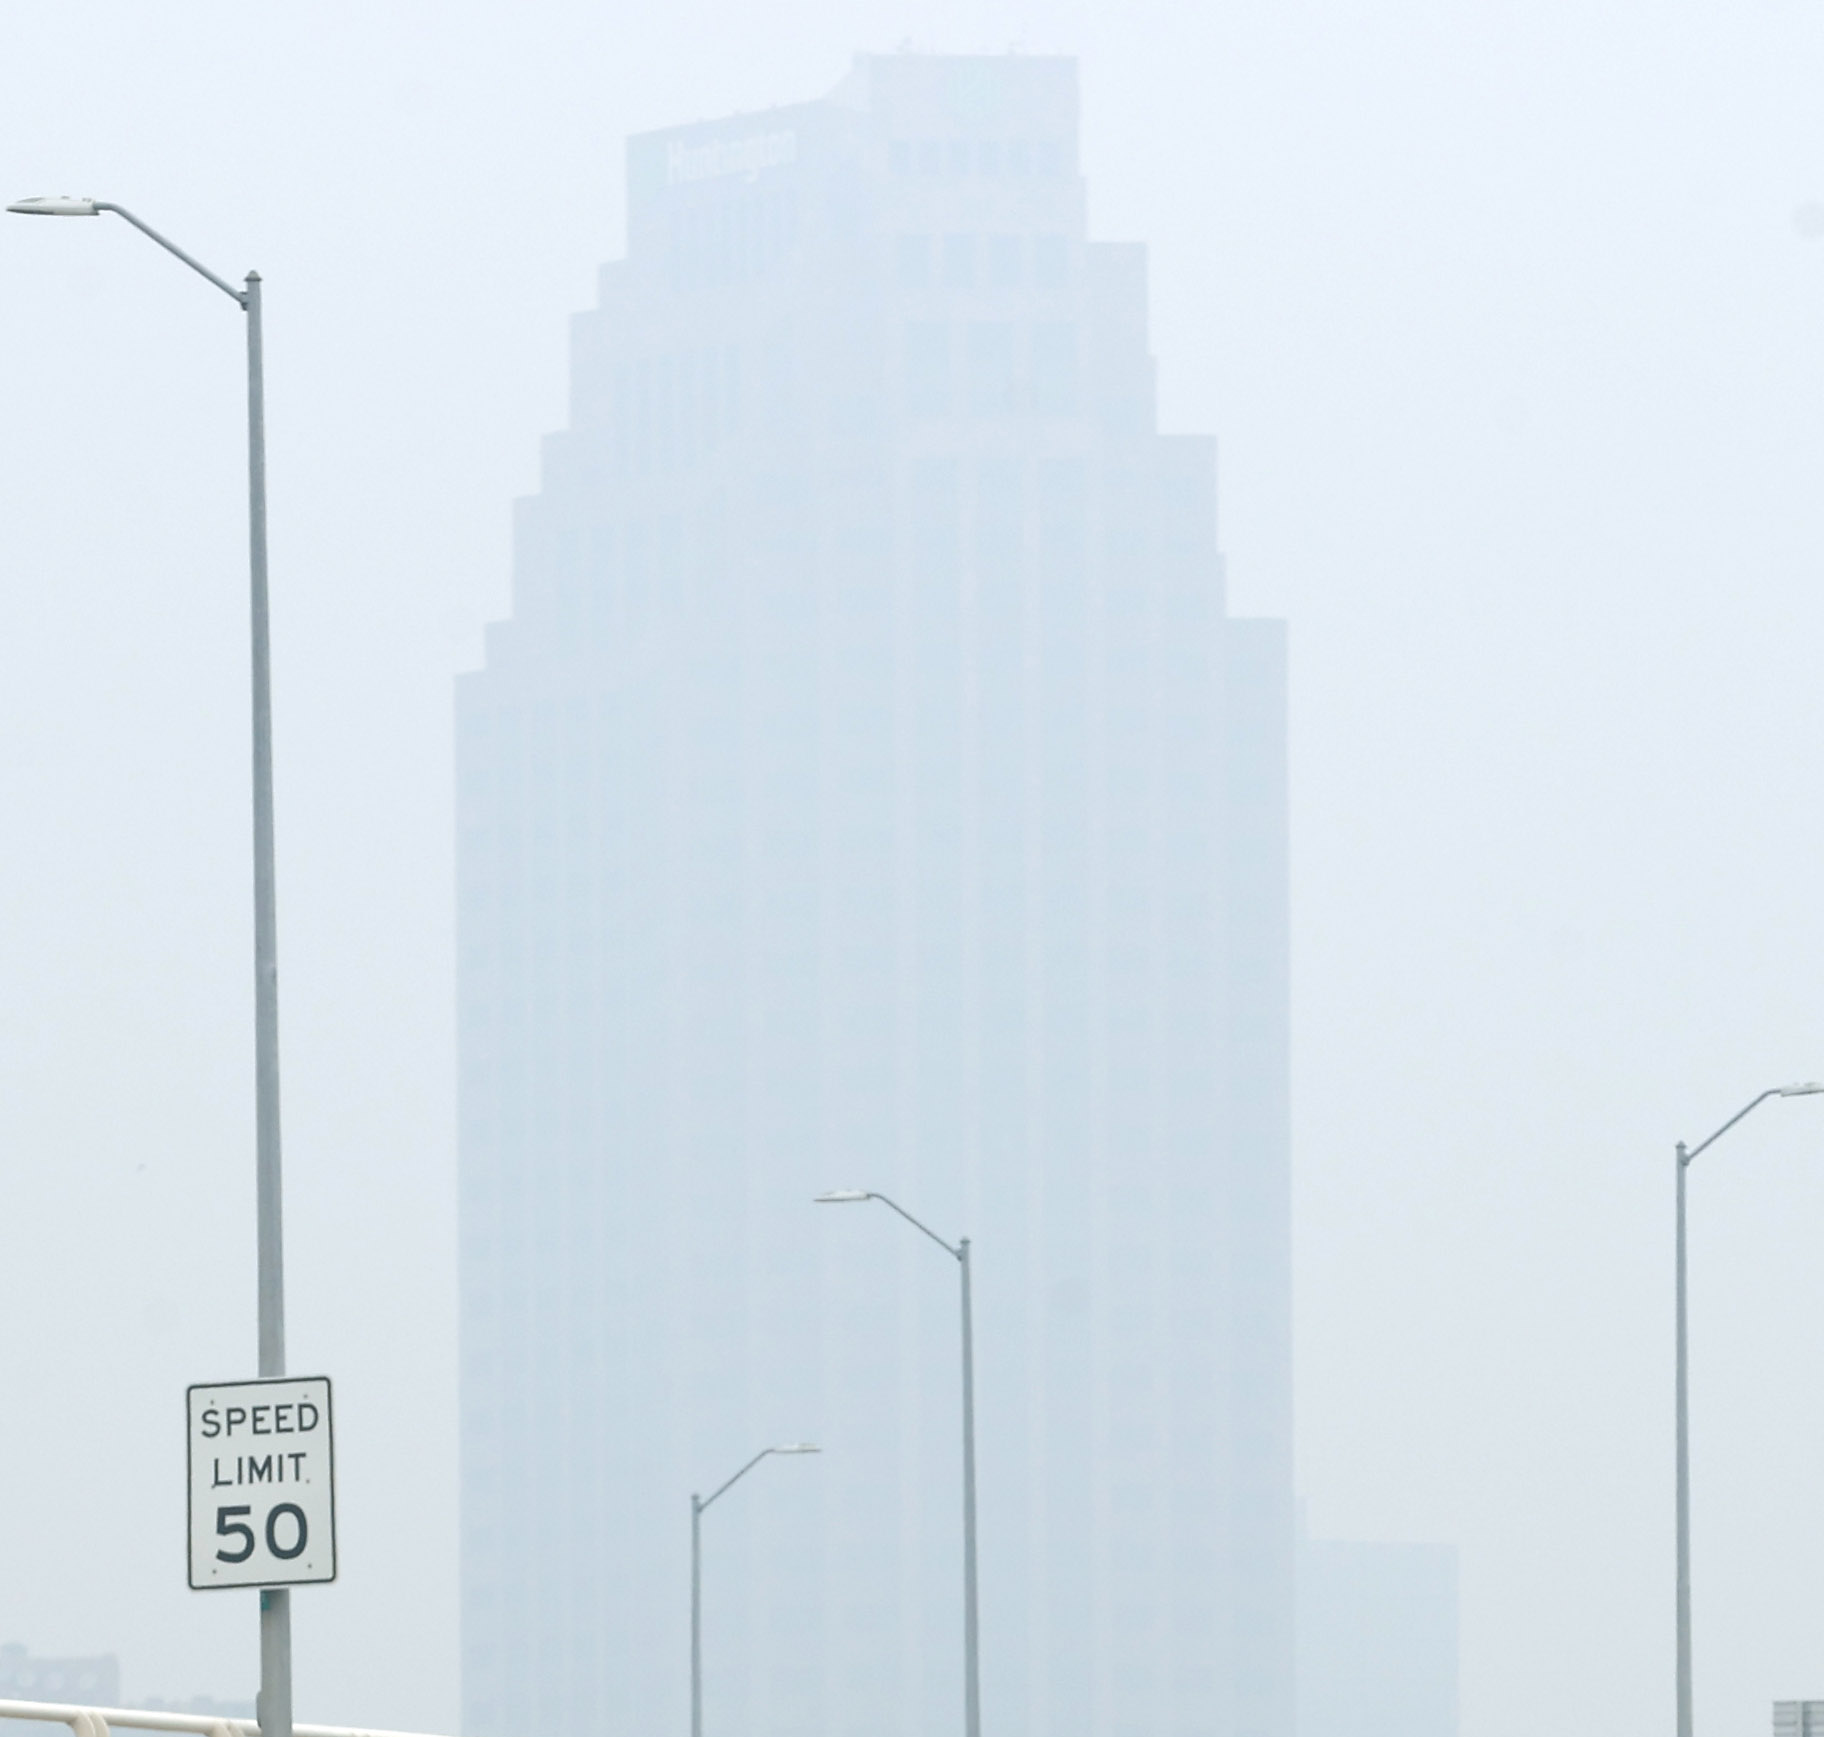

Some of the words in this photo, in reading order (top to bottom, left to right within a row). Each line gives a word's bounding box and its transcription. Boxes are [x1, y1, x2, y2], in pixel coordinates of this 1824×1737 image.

[201, 1403, 319, 1438] SPEED
[214, 1453, 307, 1486] LIMIT
[216, 1502, 308, 1564] 50
